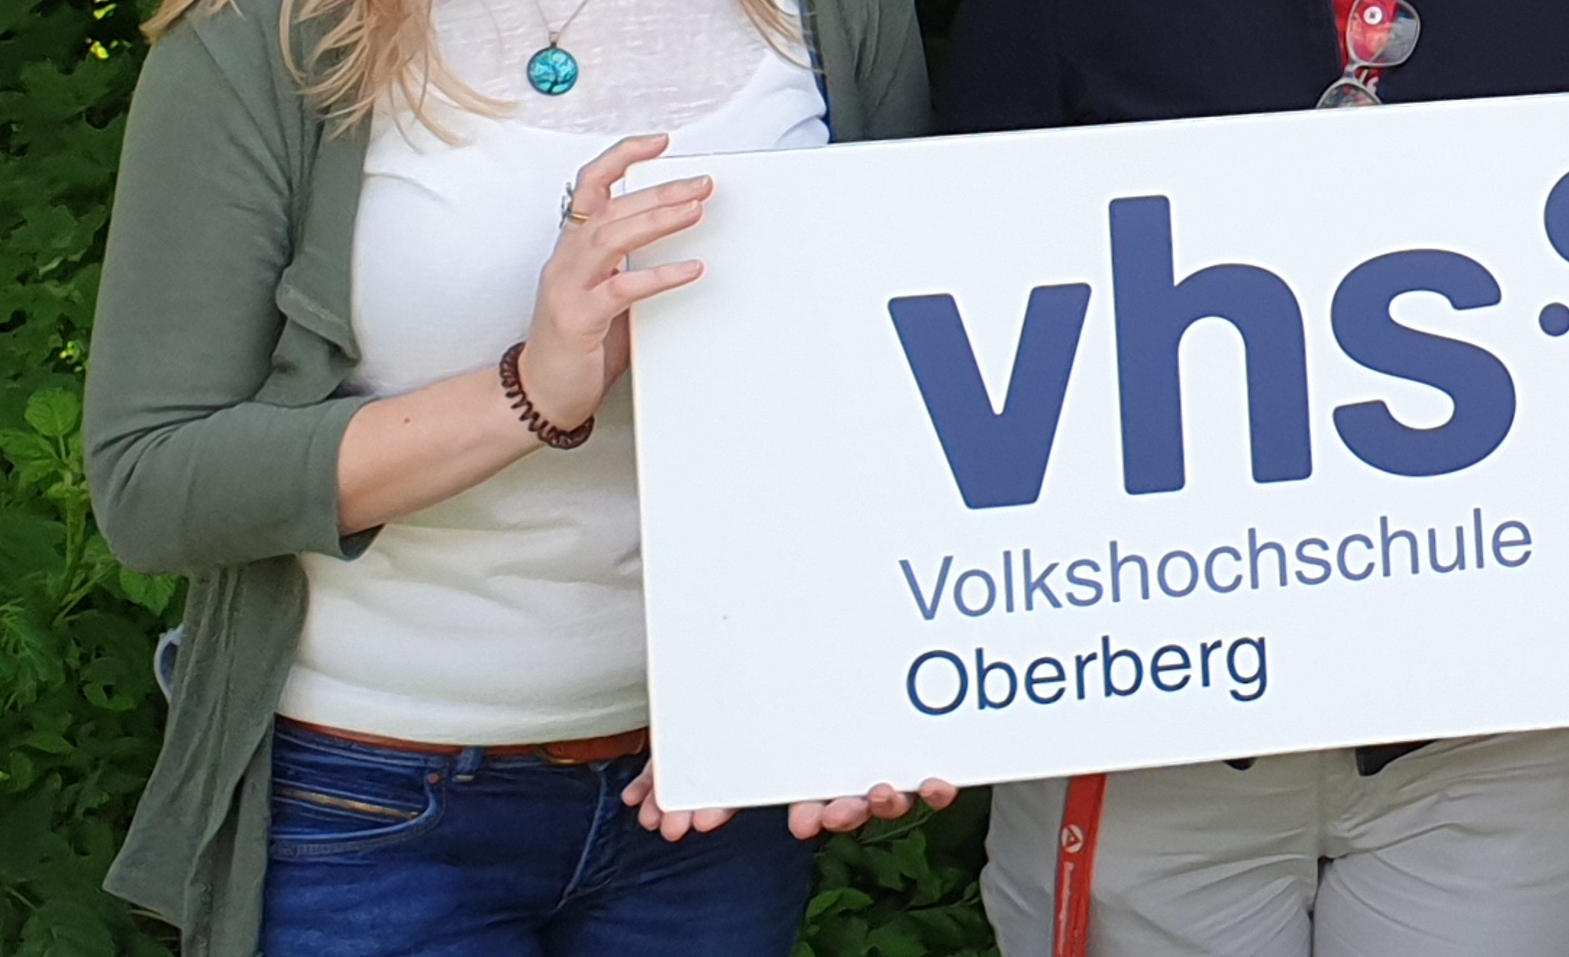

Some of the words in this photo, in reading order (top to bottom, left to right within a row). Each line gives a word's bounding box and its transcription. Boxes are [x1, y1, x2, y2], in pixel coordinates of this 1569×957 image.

[887, 195, 1517, 510] vhs
[899, 508, 1532, 621] Volkshochschule
[906, 635, 1267, 716] Oberberg
